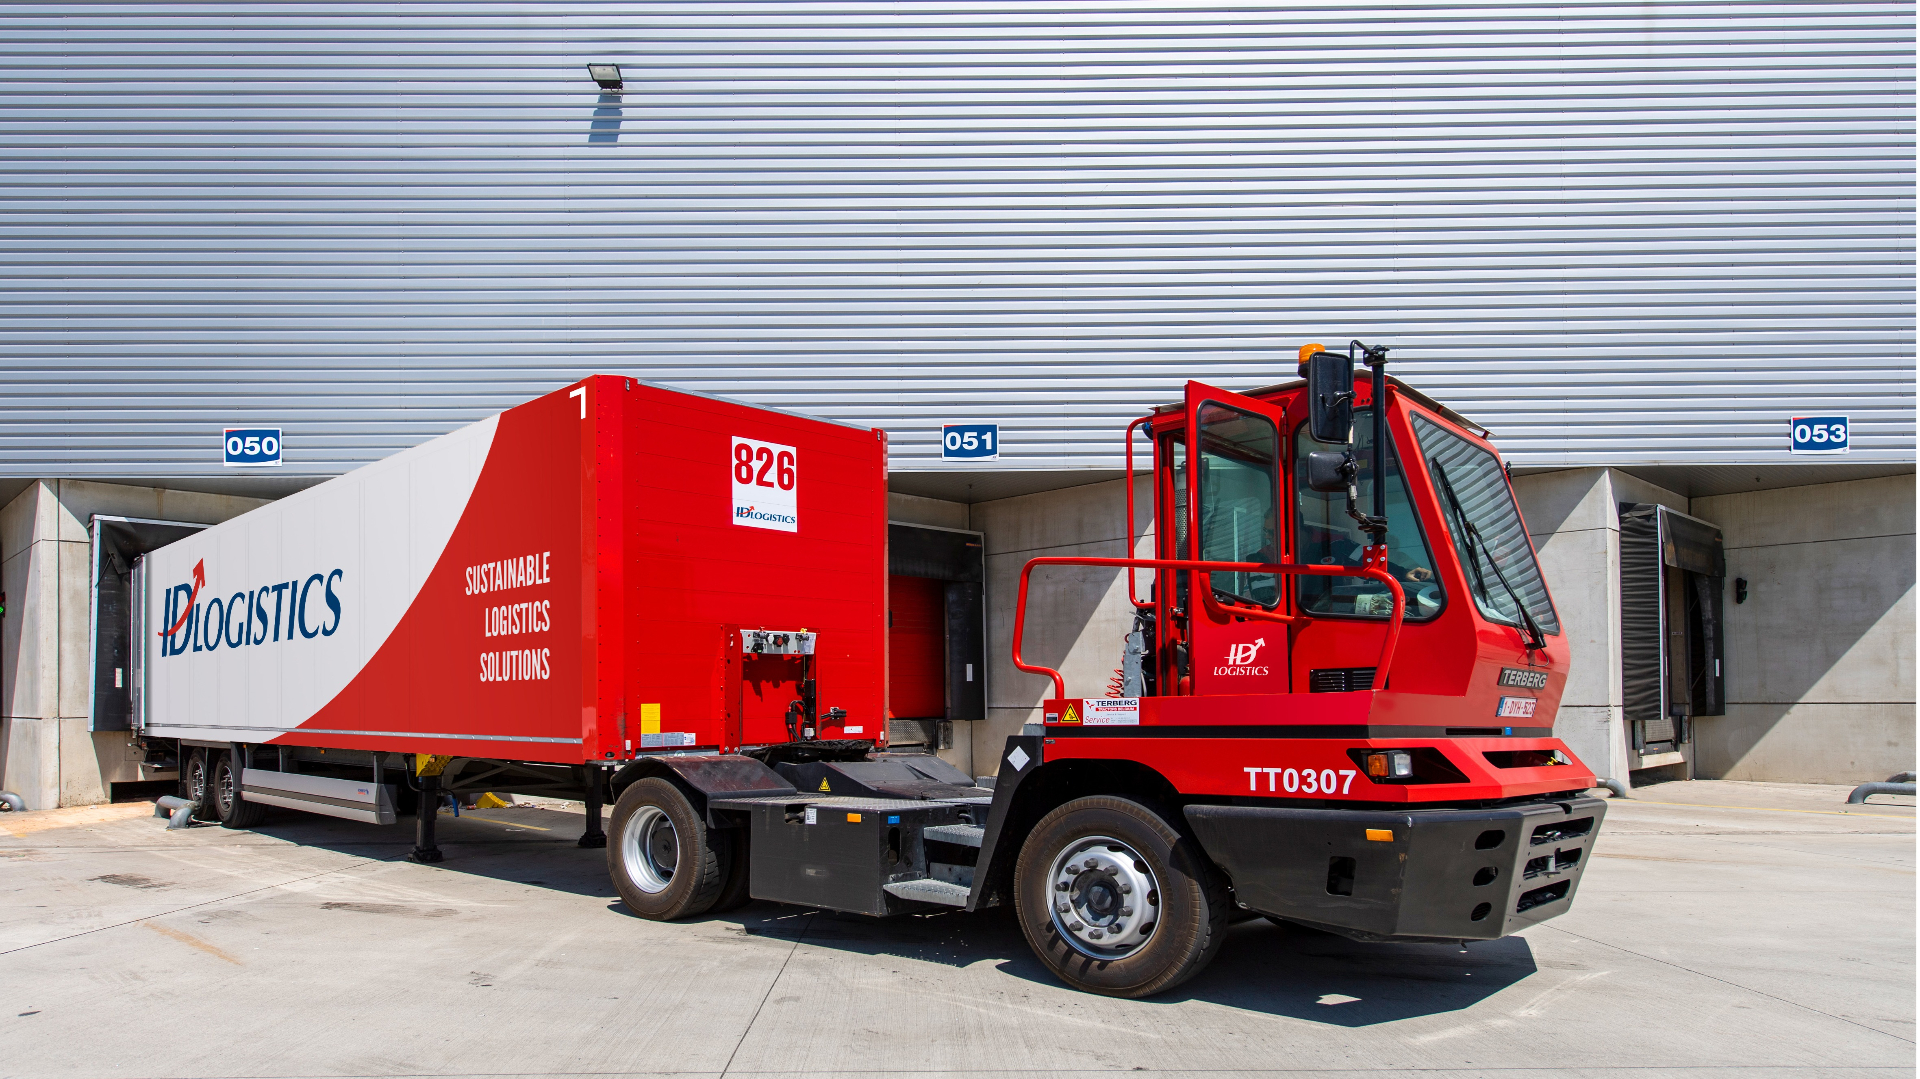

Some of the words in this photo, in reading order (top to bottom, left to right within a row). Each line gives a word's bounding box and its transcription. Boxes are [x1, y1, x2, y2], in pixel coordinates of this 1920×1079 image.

[945, 431, 992, 450] 051
[1794, 424, 1846, 443] 053
[226, 436, 278, 455] 050
[734, 443, 795, 491] 826
[465, 551, 551, 596] SUSTAINABLE
[485, 599, 551, 637] LOGISTICS
[1228, 643, 1257, 665] ID
[479, 647, 551, 682] SOLUTIONS
[1213, 666, 1269, 676] LOGISTICS
[1503, 669, 1548, 688] TERBERG
[1095, 699, 1138, 707] TERBERG
[1084, 715, 1111, 724] Service
[1243, 767, 1357, 794] TT0307
